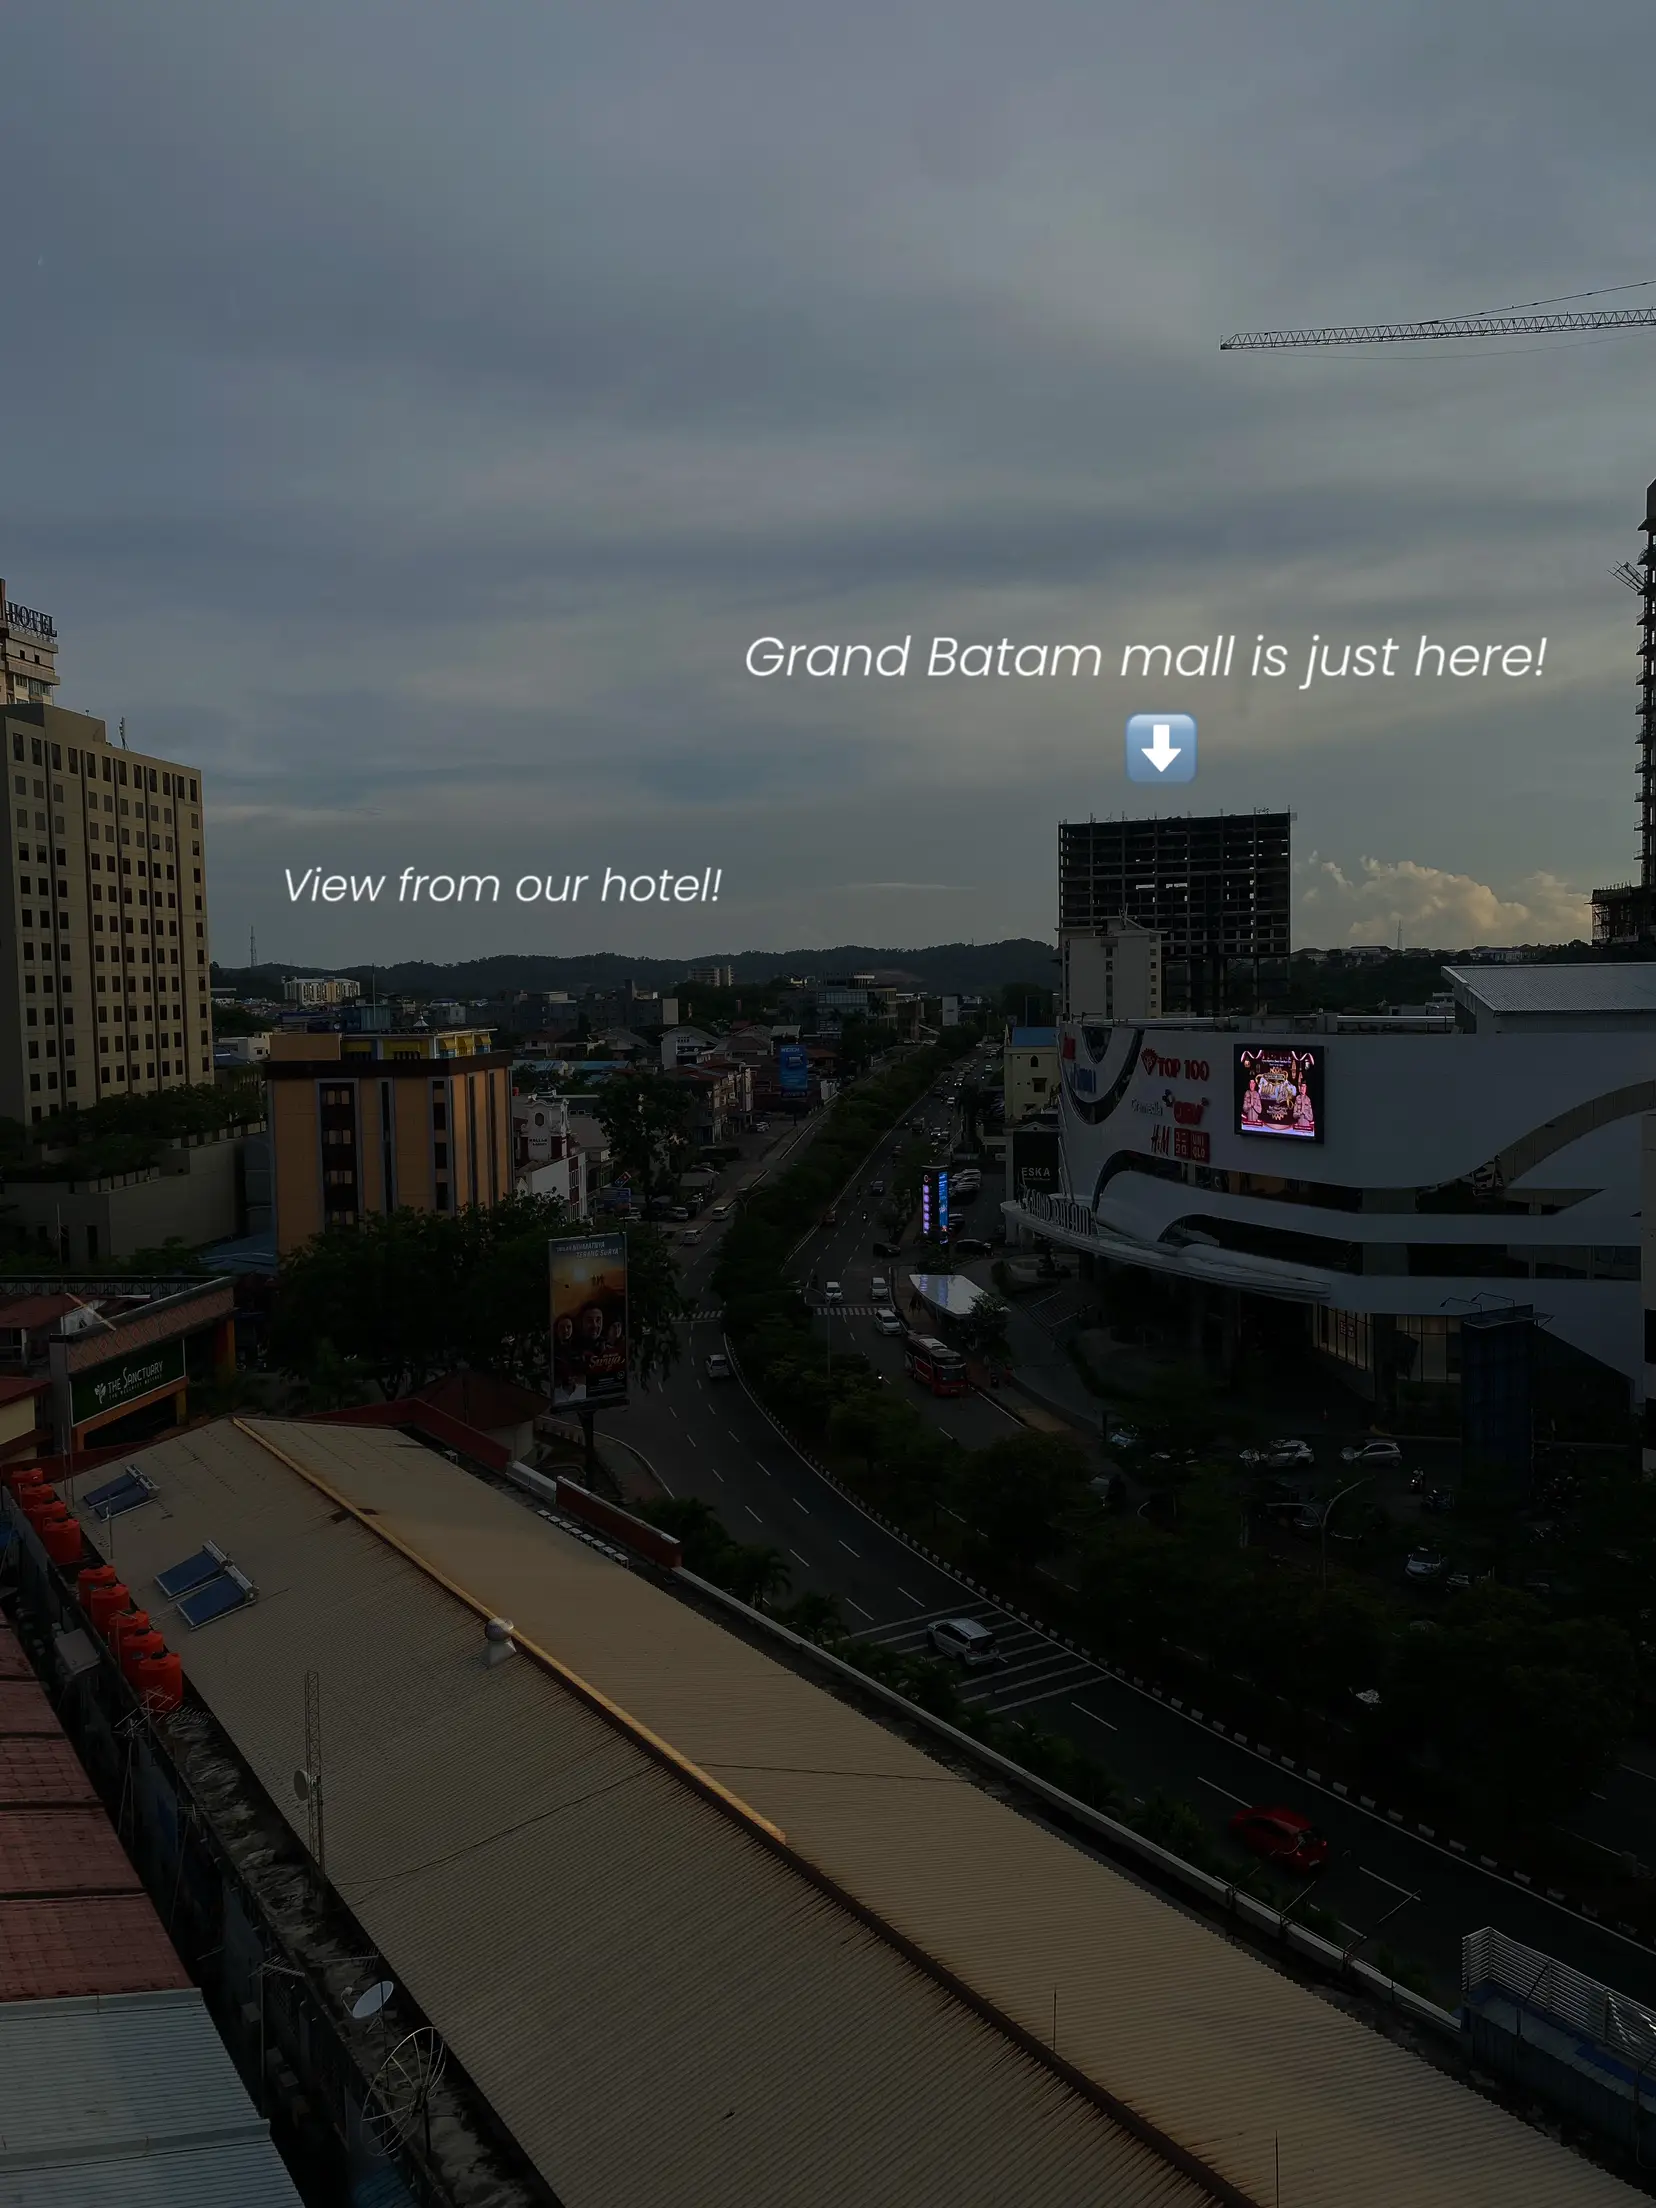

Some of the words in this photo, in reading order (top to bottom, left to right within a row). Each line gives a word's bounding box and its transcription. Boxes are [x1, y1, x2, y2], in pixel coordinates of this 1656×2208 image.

[7, 600, 57, 638] HOTEL
[1157, 1057, 1181, 1078] TOP
[1184, 1059, 1210, 1082] 100
[108, 1378, 121, 1394] THE
